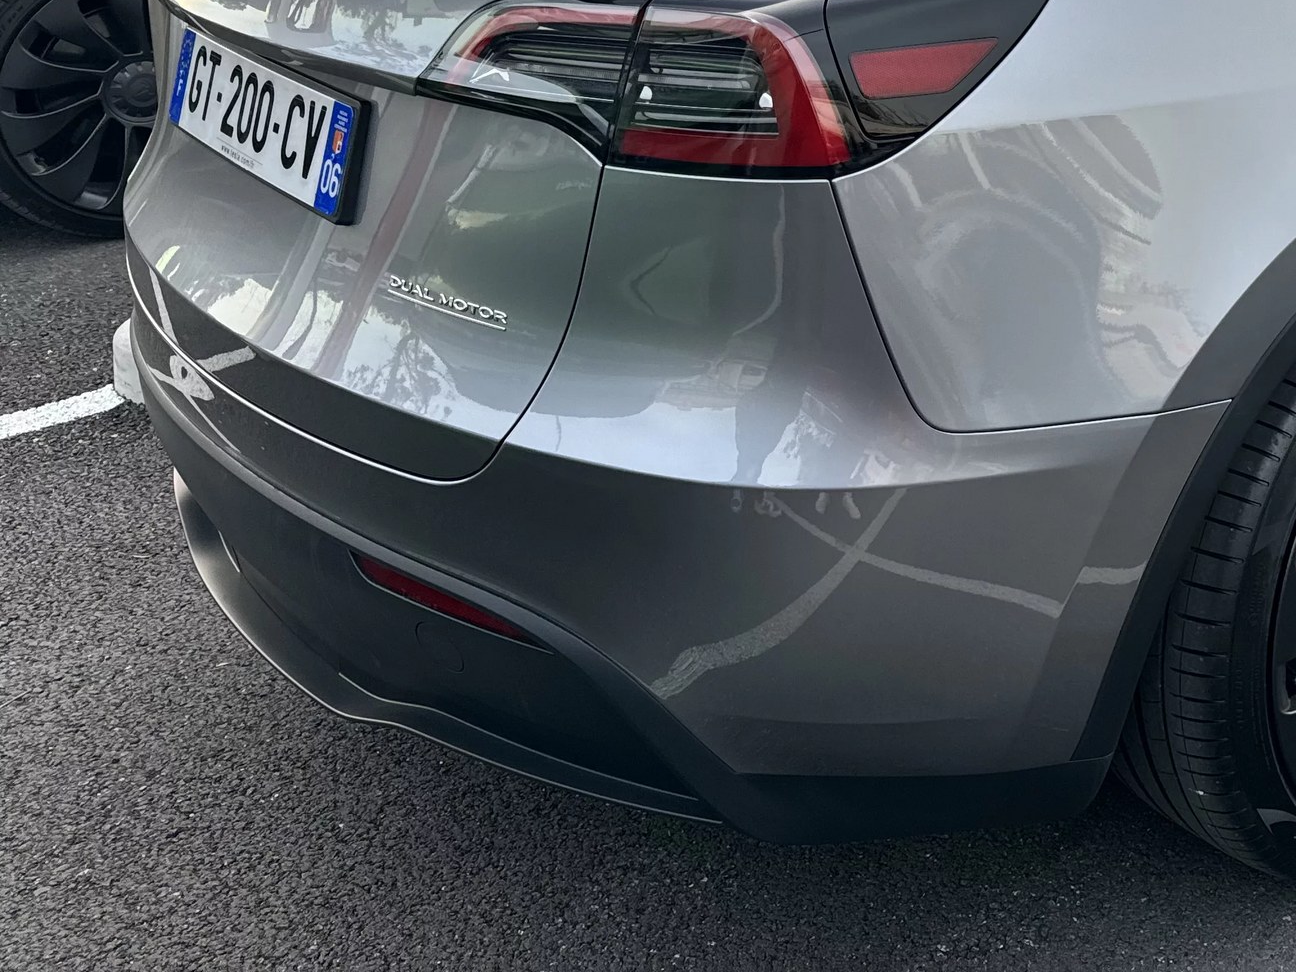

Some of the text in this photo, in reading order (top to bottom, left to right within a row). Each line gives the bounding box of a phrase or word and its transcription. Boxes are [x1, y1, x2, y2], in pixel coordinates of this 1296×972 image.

[176, 78, 184, 97] F
[188, 45, 328, 180] GT-200-CV
[320, 158, 342, 198] 06
[389, 275, 508, 325] DUAL MOTOR
